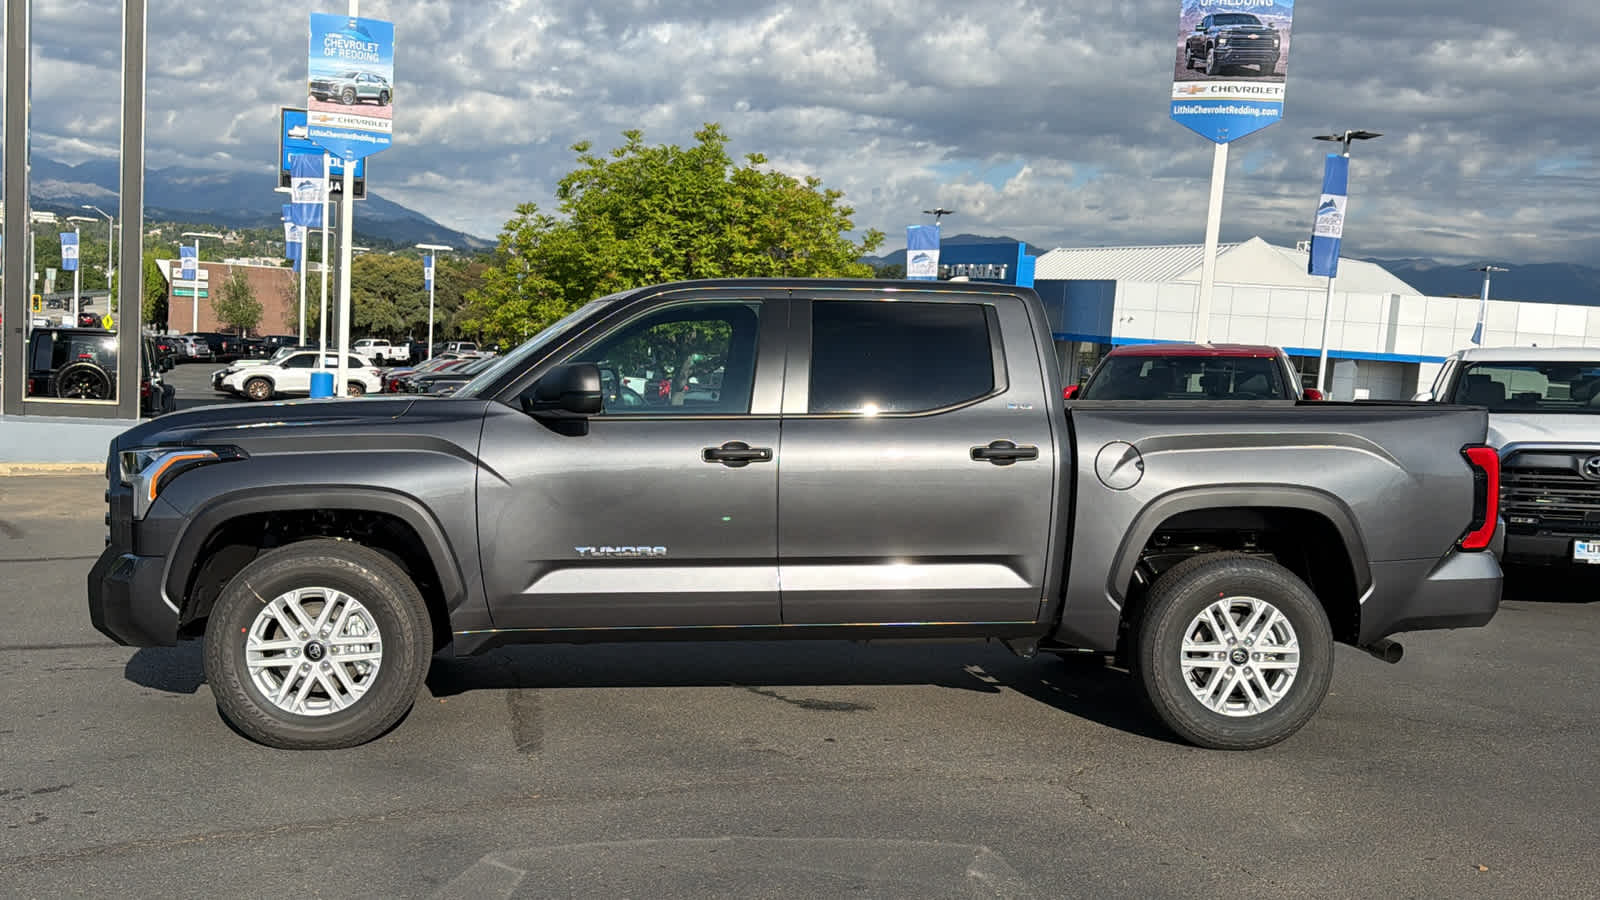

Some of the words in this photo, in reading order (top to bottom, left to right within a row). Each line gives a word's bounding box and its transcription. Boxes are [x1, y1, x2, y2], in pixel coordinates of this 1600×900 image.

[323, 37, 379, 52] CHEVROLET
[323, 47, 337, 57] OF
[338, 49, 379, 63] REDDING
[1211, 85, 1280, 95] CHEVROLET
[1173, 105, 1279, 117] LithiaChevroletRedding.com
[337, 116, 390, 128] CHEVROLET
[574, 546, 668, 557] TUNDRA
